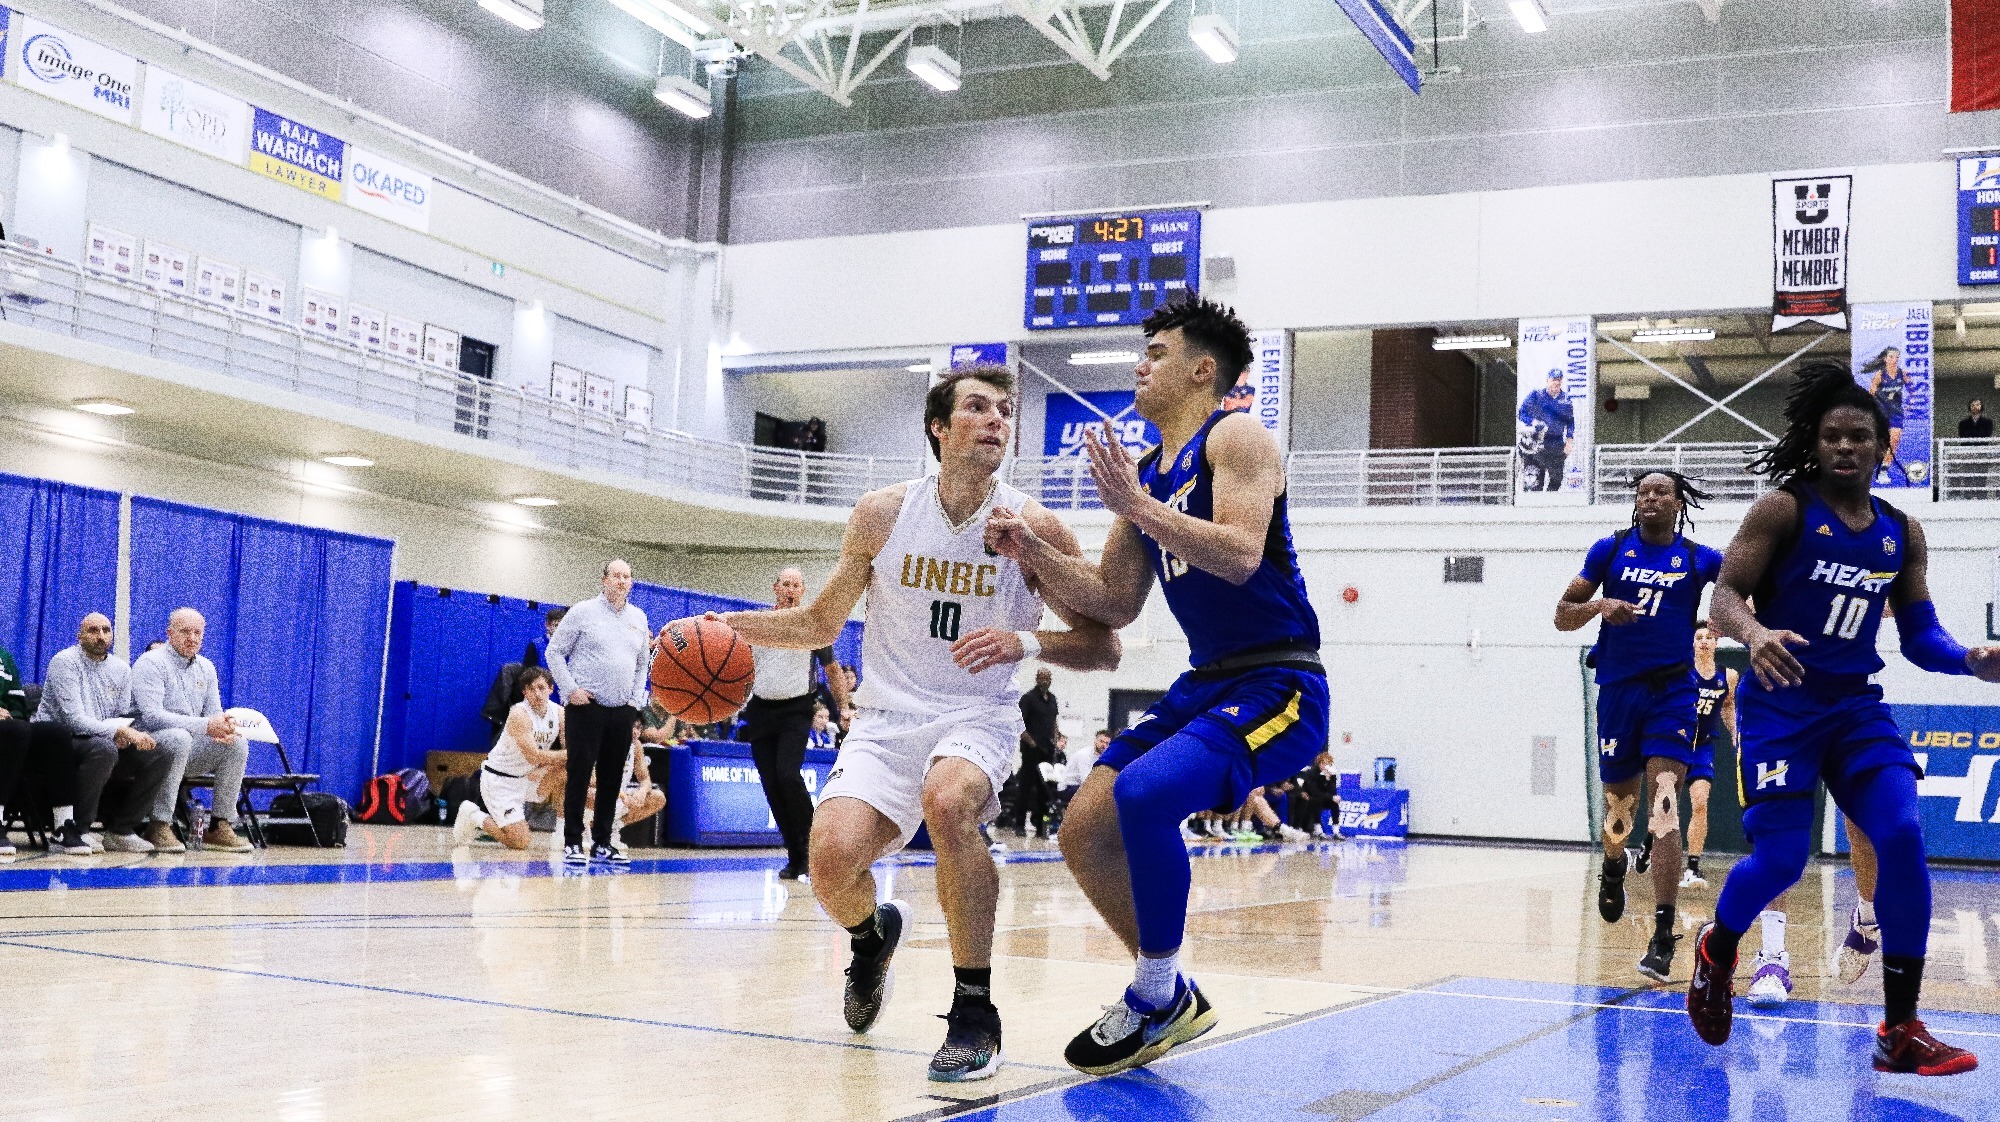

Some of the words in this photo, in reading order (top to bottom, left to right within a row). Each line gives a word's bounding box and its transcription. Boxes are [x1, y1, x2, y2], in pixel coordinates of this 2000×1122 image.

[37, 49, 93, 80] Image
[98, 73, 131, 94] One
[93, 85, 130, 110] MRI
[280, 119, 320, 149] RAJA
[256, 130, 340, 180] WARIACH
[265, 161, 327, 192] LAWYER
[352, 163, 425, 205] OKAPED
[1795, 200, 1829, 210] SPORTS
[1094, 217, 1143, 242] 4:27
[1782, 227, 1840, 256] MEMBER
[1970, 235, 1998, 246] FOULS
[1152, 241, 1184, 254] GUEST
[1782, 257, 1839, 287] MEMBRE
[1970, 270, 1999, 281] SCORE
[1567, 337, 1587, 401] TOWILL
[1906, 323, 1929, 420] IBBETSON
[1261, 349, 1280, 429] EMERSON
[900, 553, 997, 597] UNBC
[1620, 566, 1687, 588] HEAT
[1809, 559, 1899, 594] HEAT
[1633, 587, 1664, 617] 21
[1822, 593, 1869, 640] 10
[929, 599, 962, 642] 10
[1910, 730, 1973, 749] UBC
[701, 765, 730, 782] HOME
[730, 766, 743, 783] OF
[744, 767, 762, 784] THE
